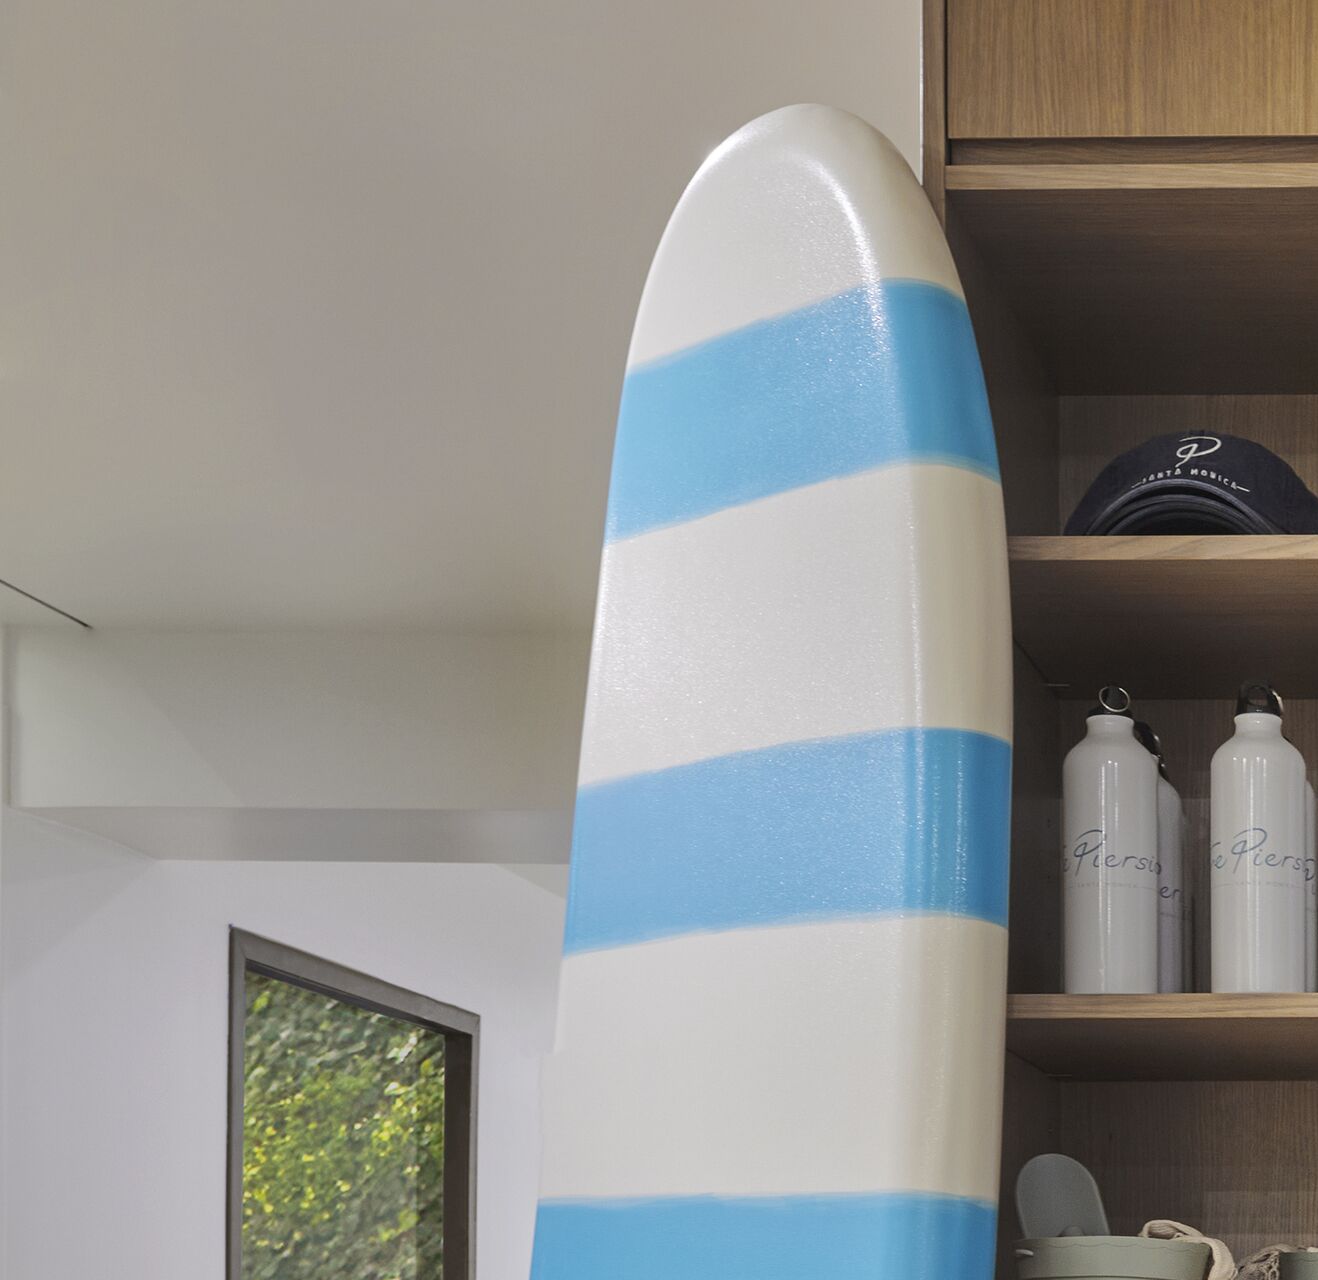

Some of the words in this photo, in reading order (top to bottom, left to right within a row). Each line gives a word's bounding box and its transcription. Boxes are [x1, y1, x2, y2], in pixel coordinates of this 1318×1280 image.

[1175, 435, 1222, 468] P
[1190, 468, 1238, 490] MONICA
[1073, 828, 1158, 877] Piersi
[1230, 827, 1304, 874] Piers
